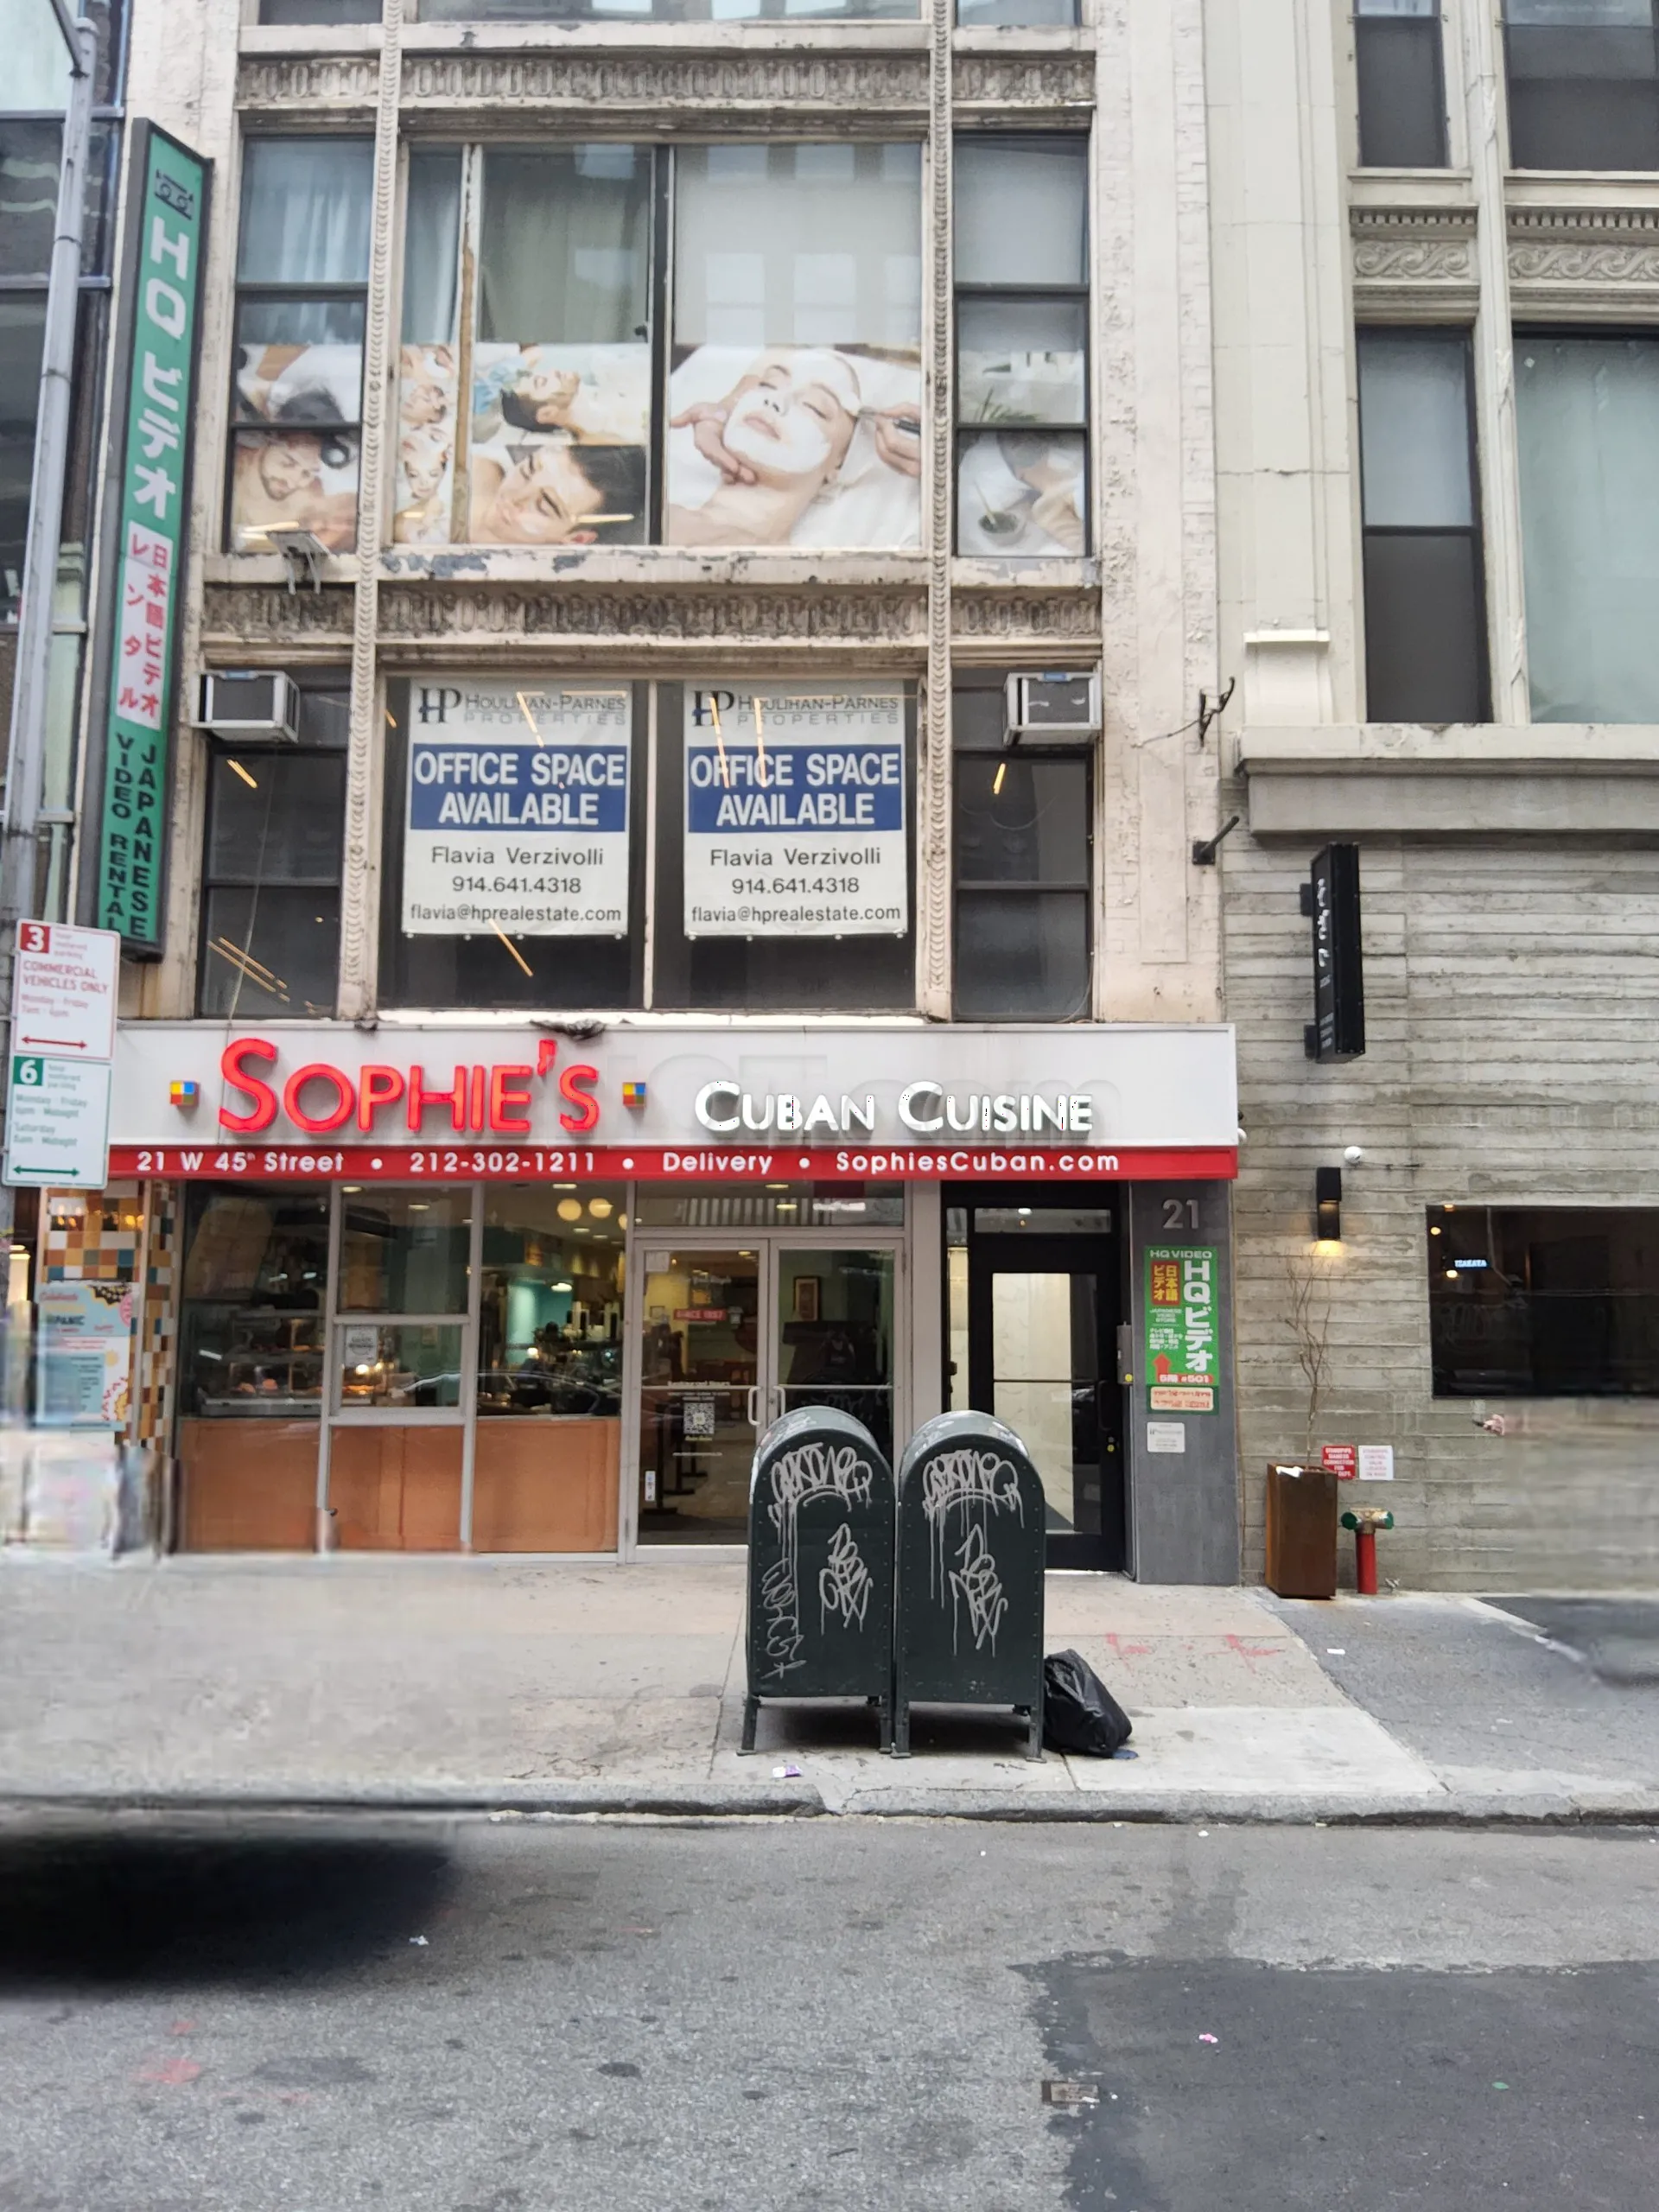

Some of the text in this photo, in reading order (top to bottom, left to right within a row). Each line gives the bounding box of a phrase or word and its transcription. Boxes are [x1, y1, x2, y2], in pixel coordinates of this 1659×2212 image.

[418, 687, 461, 723] HP
[463, 712, 626, 726] PROPERTIES
[415, 750, 626, 786] OFFICE SPACE
[690, 753, 899, 787] OFFICE SPACE
[438, 792, 600, 825] AVAILABLE
[715, 793, 874, 826] AVAILABLE
[106, 733, 135, 936] VIDEO RENTAL
[129, 744, 157, 939] JAPANESE
[432, 846, 604, 866] Flavia Verzivolli
[710, 848, 881, 866] Flavia Verzivolli
[452, 876, 582, 893] 914.641.4318
[732, 877, 860, 893] 914.641.4318
[410, 903, 622, 925] flavia@hprealestate.com
[692, 906, 901, 925] flavia@hprealestate.com
[26, 925, 44, 951] 3
[22, 960, 98, 978] COMMERCIAL
[23, 975, 108, 994] VEHICLES ONLY
[20, 1059, 38, 1084] 6
[694, 1080, 1094, 1133] CUBAN CUISINE
[137, 1153, 164, 1173] 21
[179, 1153, 206, 1173] W
[264, 1152, 345, 1173] Street
[410, 1152, 595, 1173] 212-302-1211
[662, 1152, 773, 1175] Delivery
[836, 1152, 1120, 1175] SophiesCuban.com
[1162, 1199, 1199, 1229] 21
[1149, 1249, 1212, 1259] HQ VIDEO
[1184, 1260, 1213, 1372] HQビデオ
